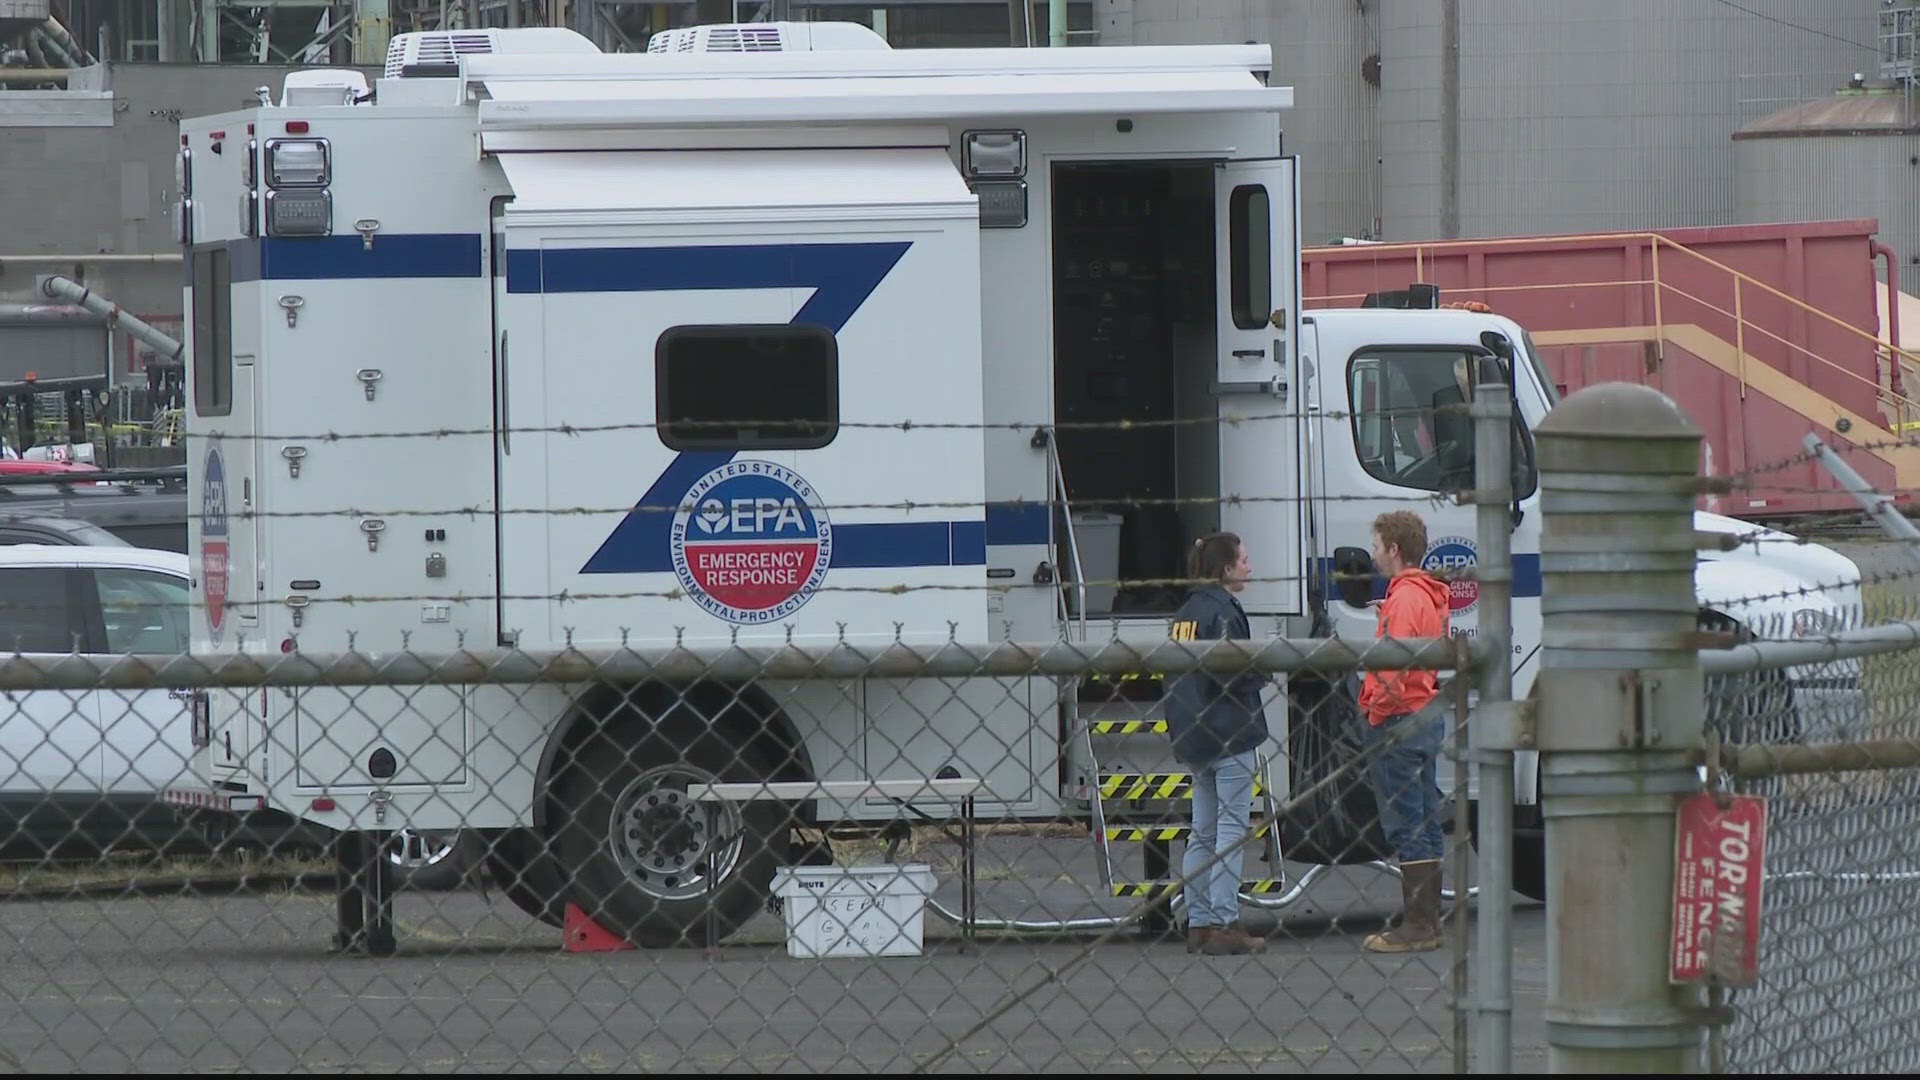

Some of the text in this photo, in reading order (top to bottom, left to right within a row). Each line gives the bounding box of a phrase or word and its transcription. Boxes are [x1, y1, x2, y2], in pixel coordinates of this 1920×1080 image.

[690, 463, 811, 500] UNITED STATES
[731, 497, 806, 533] EPA
[673, 520, 829, 622] ENVIRONMENTAL PROTECTION AGENCY
[699, 551, 805, 569] EMERGENCY
[706, 568, 798, 586] RESPONSE
[1450, 581, 1479, 589] GENCY
[1696, 858, 1715, 970] FENCE
